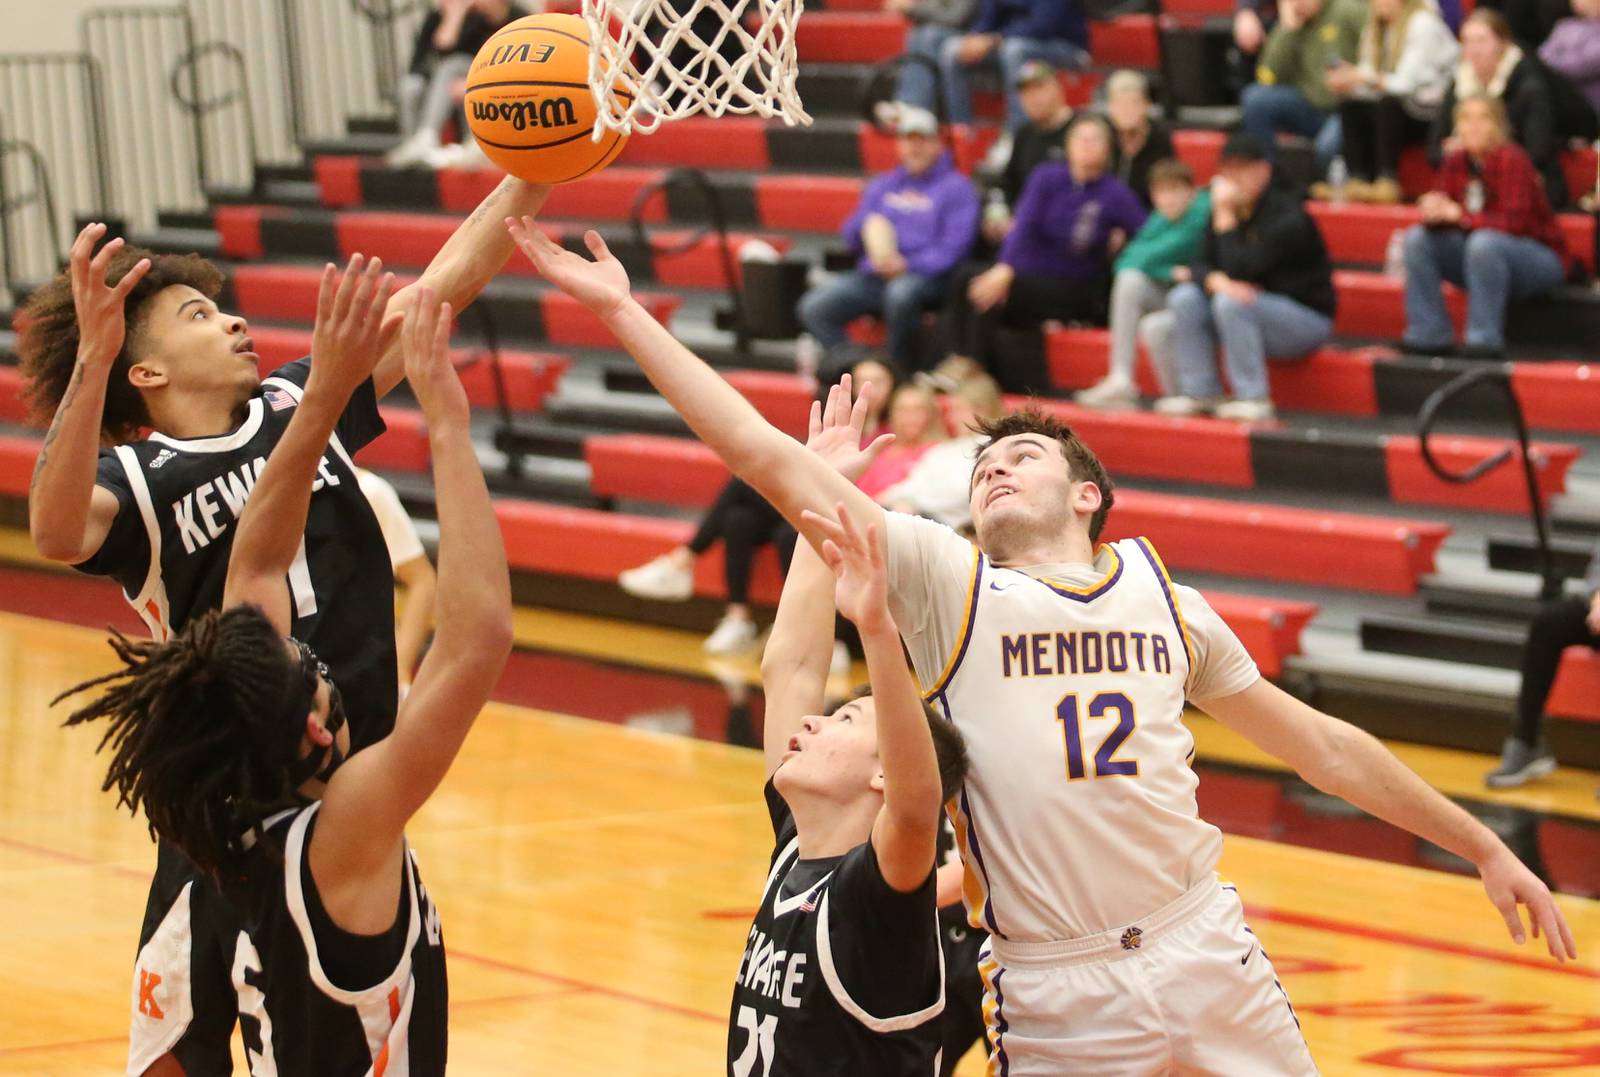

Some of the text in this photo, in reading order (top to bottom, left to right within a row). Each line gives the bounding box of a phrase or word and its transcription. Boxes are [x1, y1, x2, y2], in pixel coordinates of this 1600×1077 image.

[472, 96, 578, 131] Wilson
[1001, 631, 1172, 678] MENDOTA
[1055, 690, 1141, 783] 12
[138, 967, 165, 1021] K
